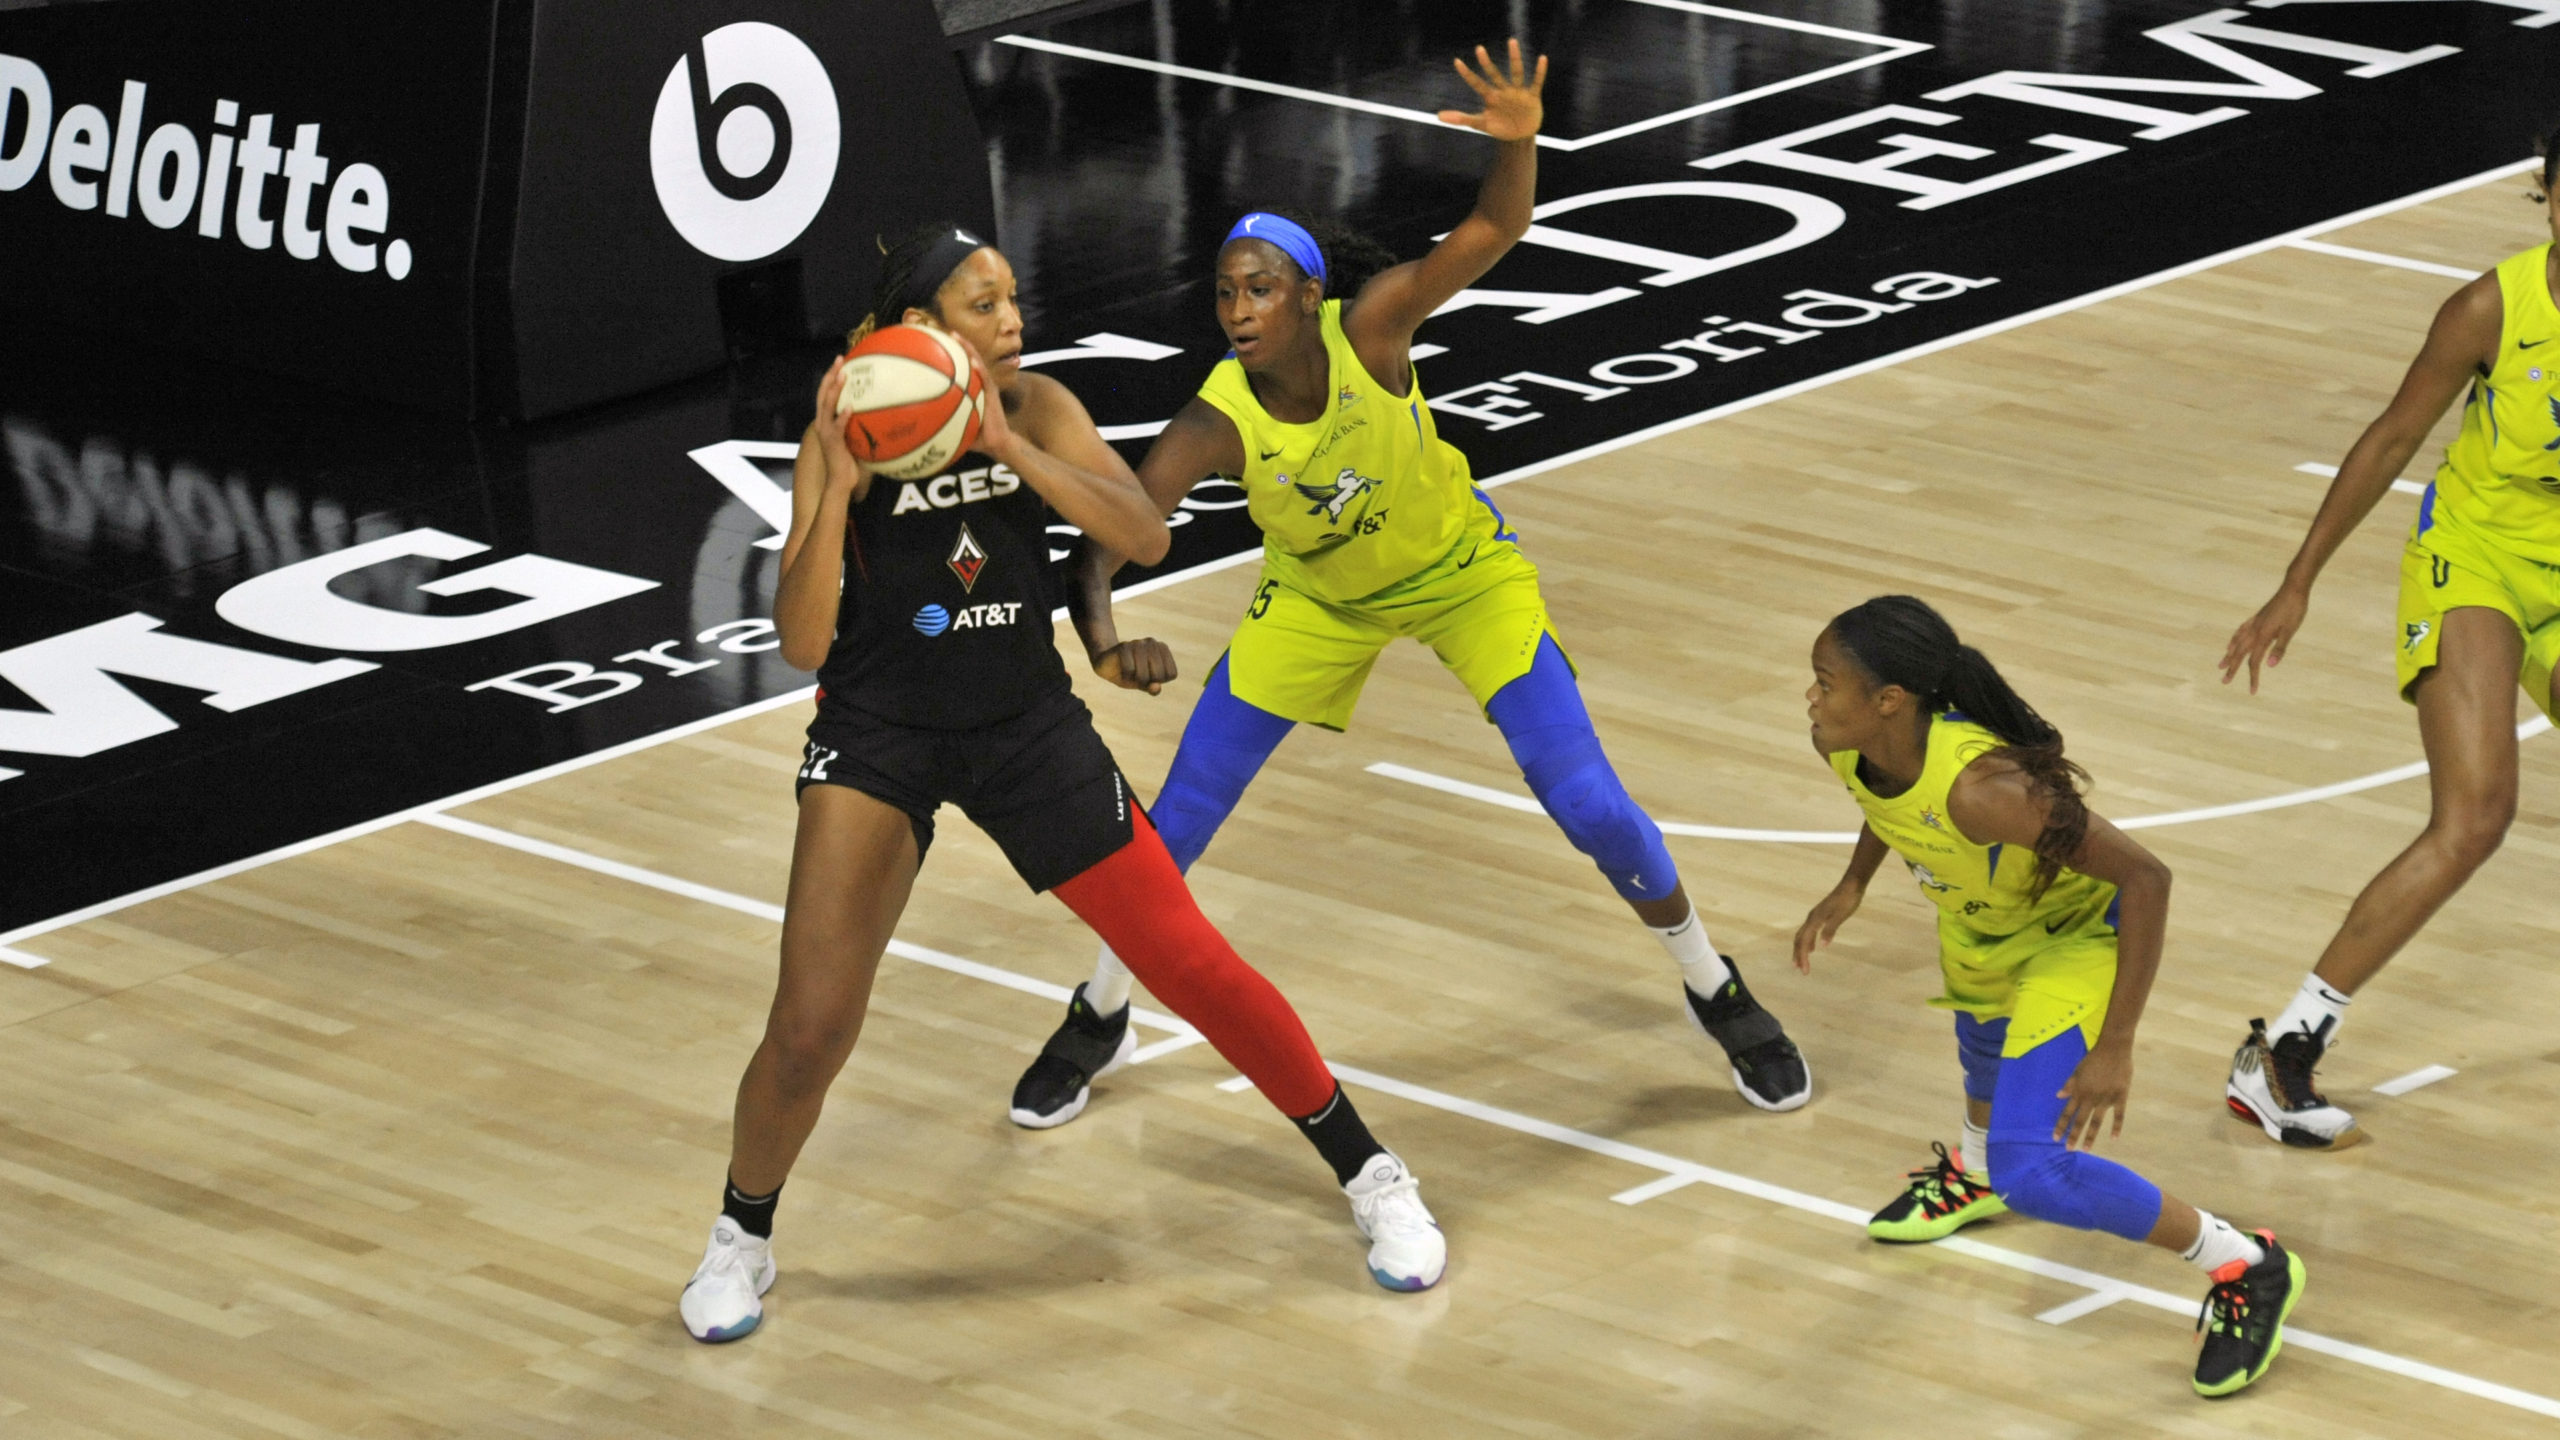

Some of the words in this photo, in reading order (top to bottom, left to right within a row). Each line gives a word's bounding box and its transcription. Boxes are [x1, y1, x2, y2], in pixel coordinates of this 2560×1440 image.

[0, 53, 412, 281] Deloitte.
[1426, 270, 2002, 433] Florida
[891, 463, 1021, 516] ACES
[953, 602, 1023, 632] AT&T
